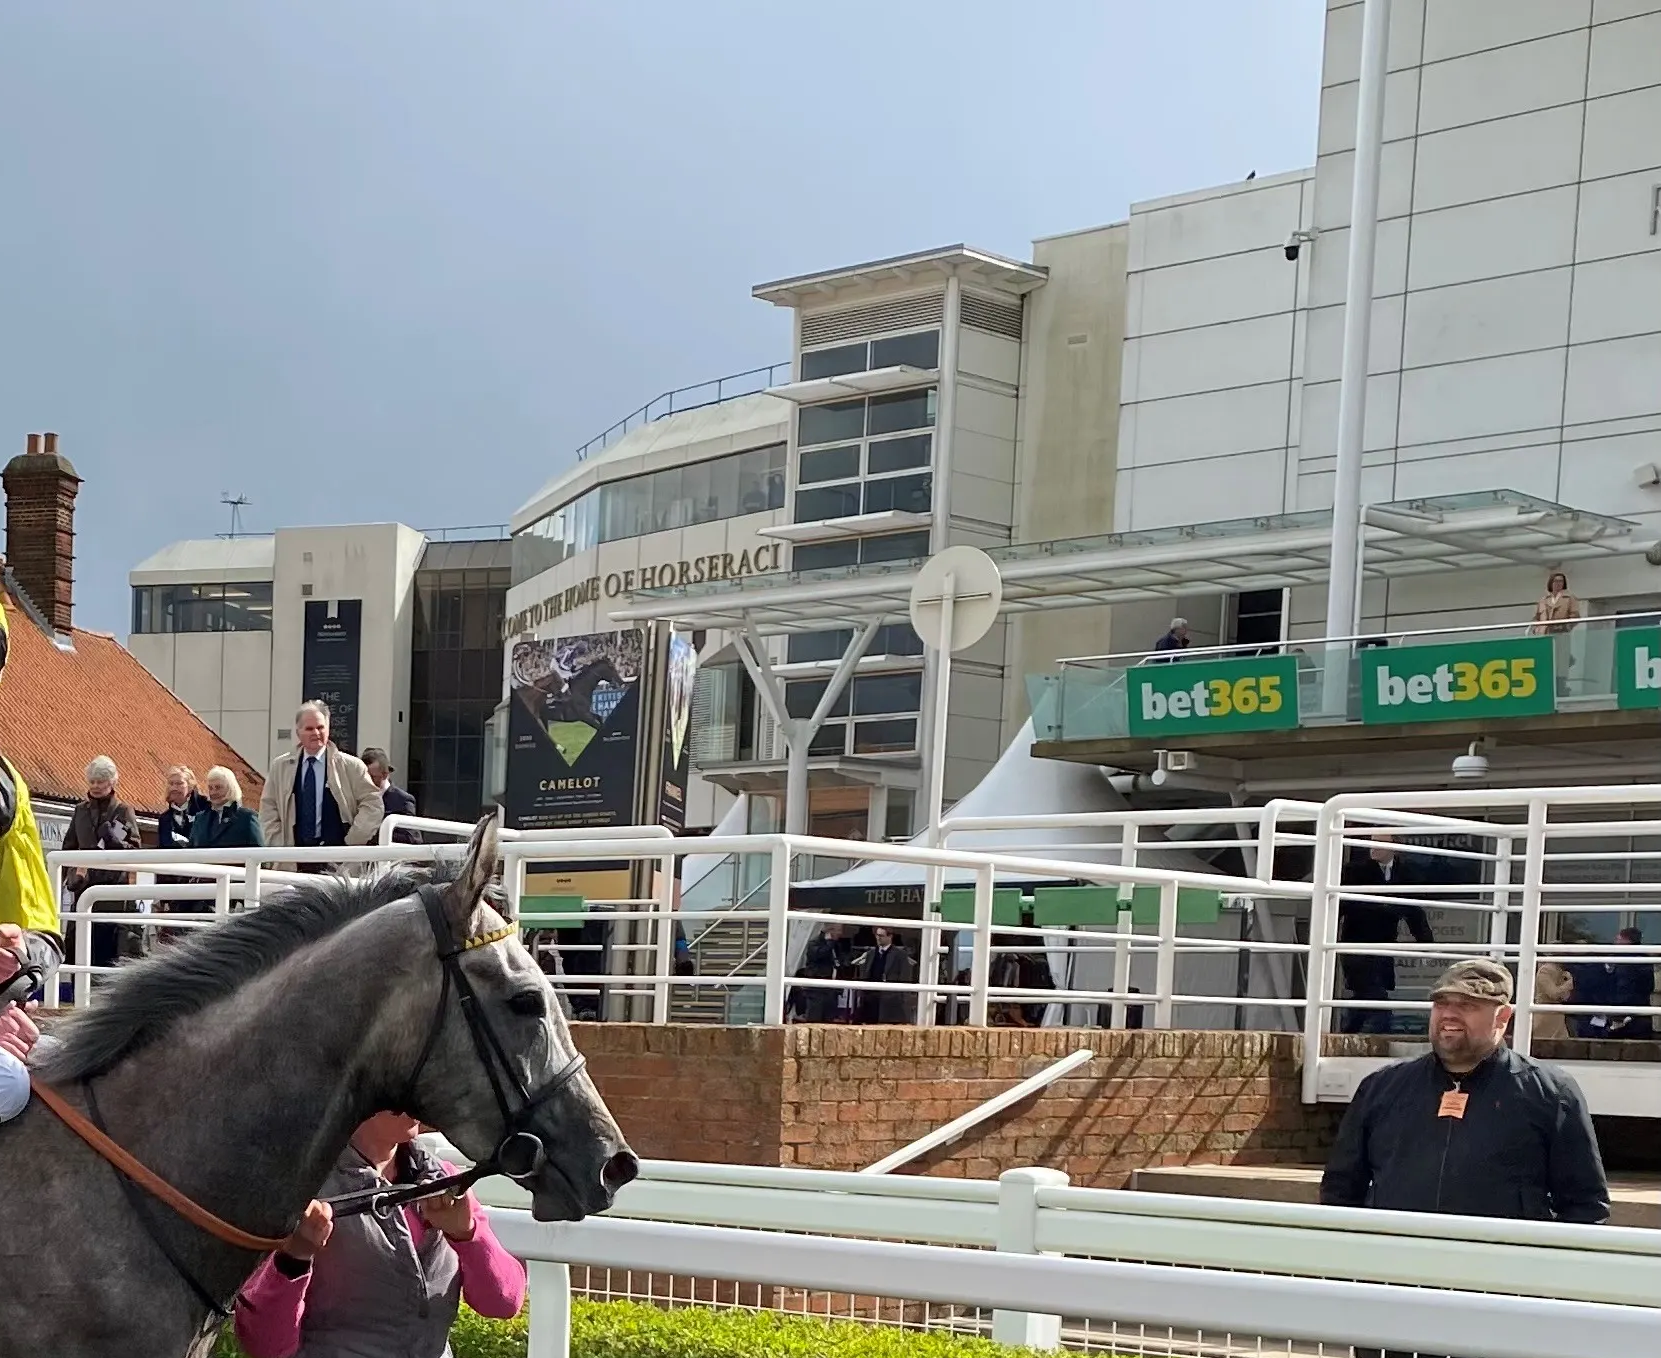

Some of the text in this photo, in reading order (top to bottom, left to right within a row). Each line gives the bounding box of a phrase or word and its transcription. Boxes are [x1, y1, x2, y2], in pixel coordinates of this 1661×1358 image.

[543, 592, 563, 622] THE
[564, 575, 600, 612] HOME
[605, 570, 635, 598] OF
[1141, 675, 1282, 720] bet365
[1375, 658, 1537, 706] bet365
[539, 776, 601, 791] CAMELOT
[865, 887, 924, 904] THE HA
